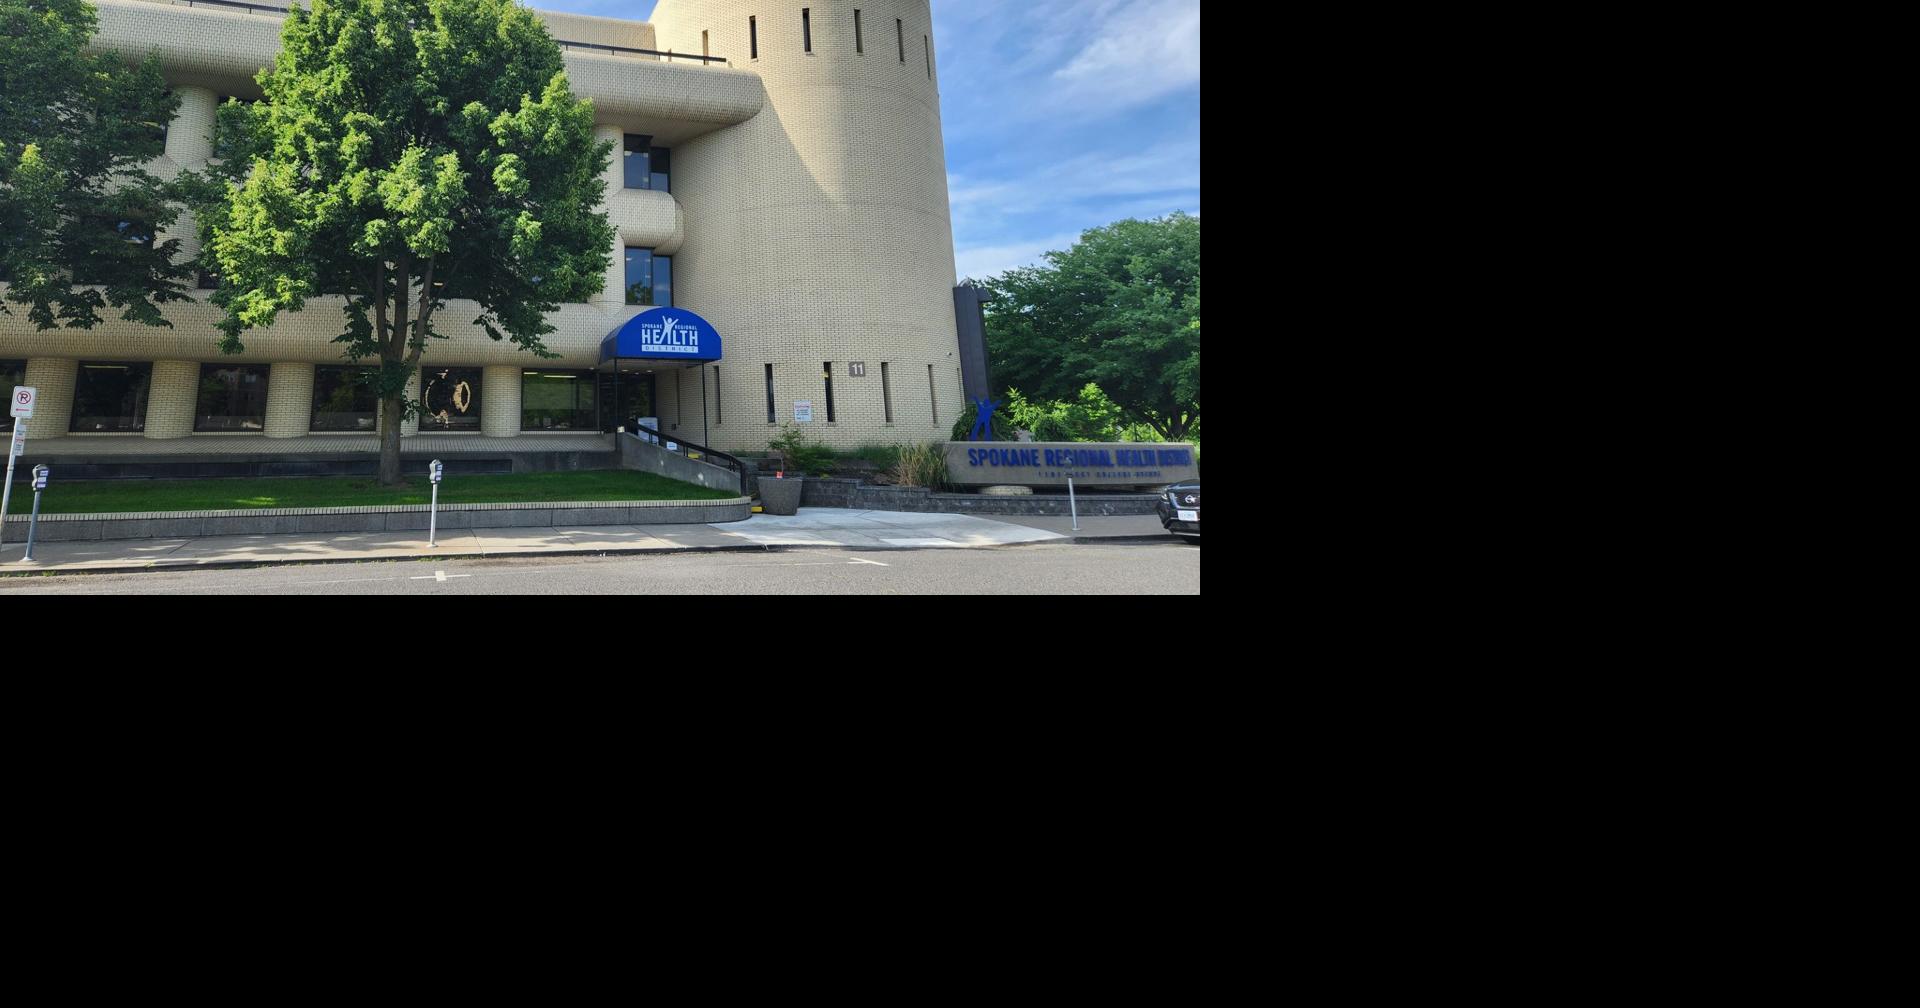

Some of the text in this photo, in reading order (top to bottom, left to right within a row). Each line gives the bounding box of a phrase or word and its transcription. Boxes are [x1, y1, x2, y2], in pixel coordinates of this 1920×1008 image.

[641, 328, 698, 346] HEALTH
[852, 363, 863, 375] 11
[967, 448, 1040, 467] SPOKANE
[1115, 449, 1157, 467] HEALTH
